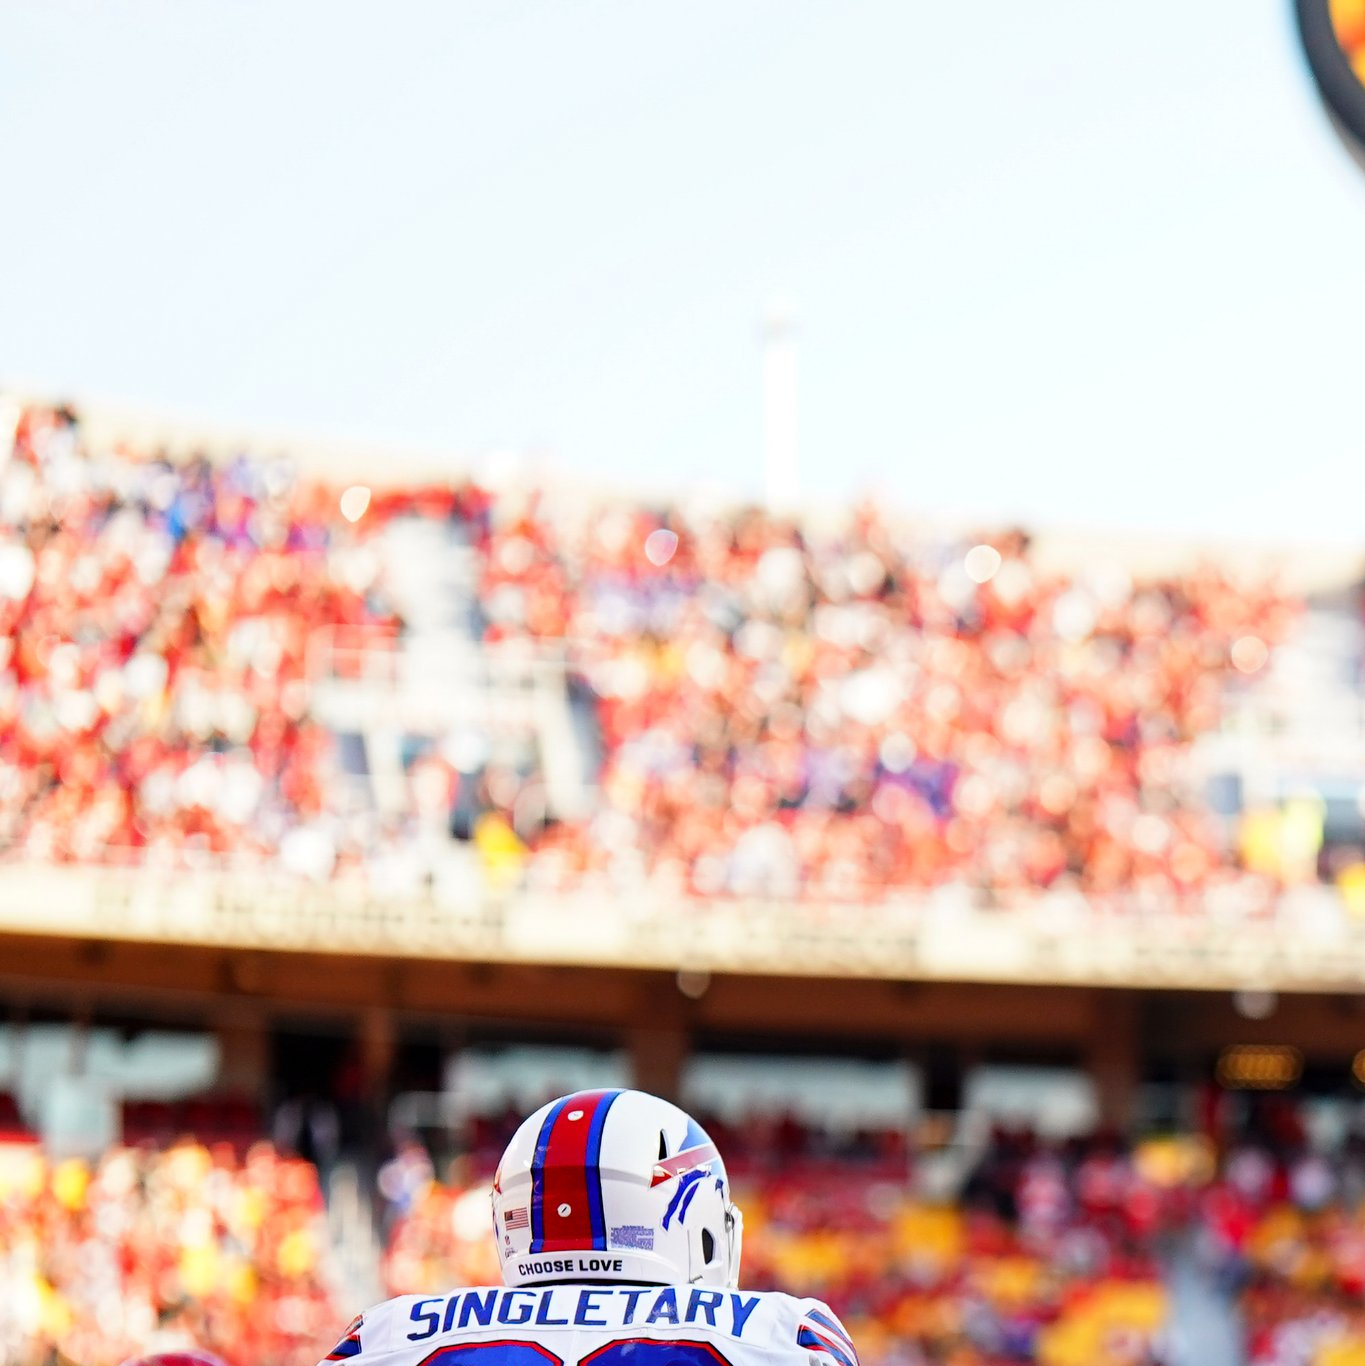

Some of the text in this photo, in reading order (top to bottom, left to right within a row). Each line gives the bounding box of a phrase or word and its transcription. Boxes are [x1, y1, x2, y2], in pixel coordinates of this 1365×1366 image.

[518, 1259, 623, 1276] CHOOSE LOVE
[406, 1288, 761, 1340] SINGLETARY
